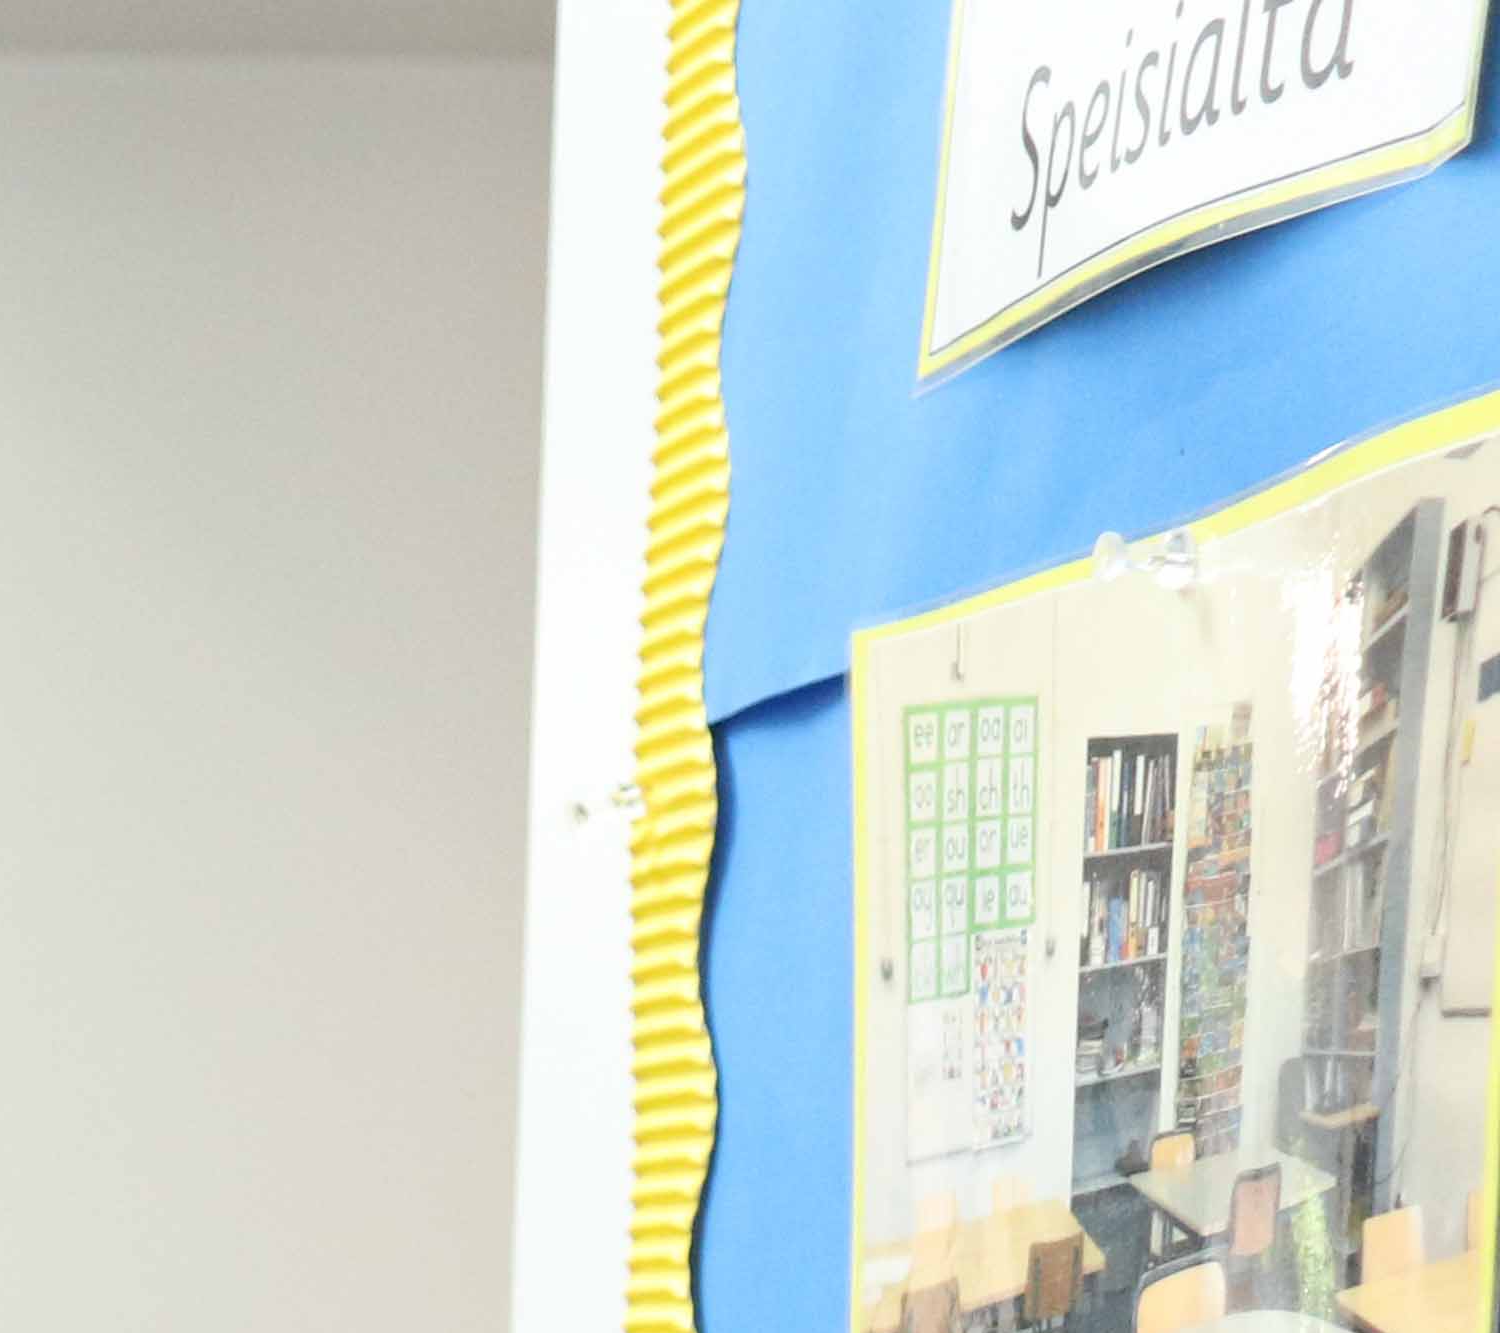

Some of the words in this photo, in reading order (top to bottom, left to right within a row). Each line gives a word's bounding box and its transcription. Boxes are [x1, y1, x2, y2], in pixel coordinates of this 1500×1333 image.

[1010, 0, 1356, 278] Speisialta
[947, 764, 965, 813] sh
[980, 768, 997, 810] ch
[1013, 760, 1030, 808] th
